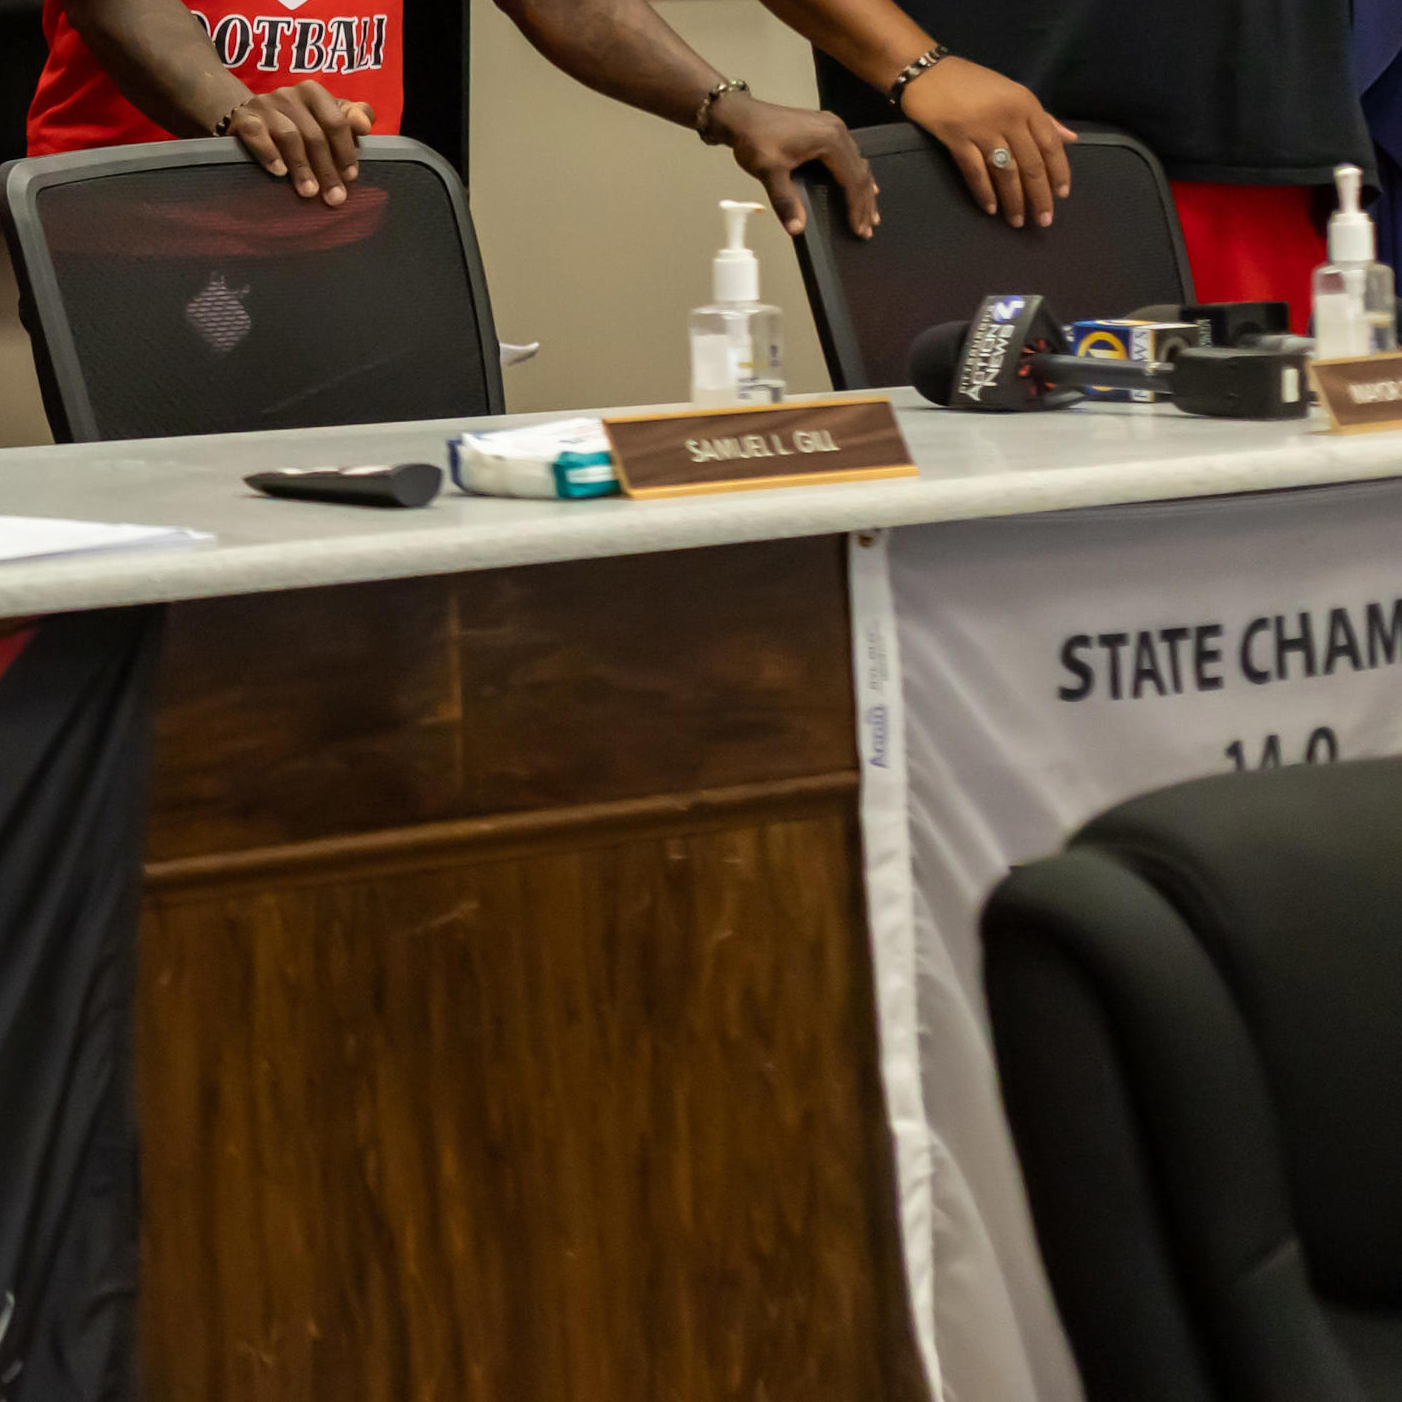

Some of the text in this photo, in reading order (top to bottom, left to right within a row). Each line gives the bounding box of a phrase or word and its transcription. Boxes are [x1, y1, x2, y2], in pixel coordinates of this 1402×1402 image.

[964, 323, 1001, 401] ACTION
[982, 324, 1015, 387] NEWS
[684, 433, 773, 463] SAMUEL
[794, 429, 841, 454] GILL
[1058, 598, 1402, 703] STATE CHAM
